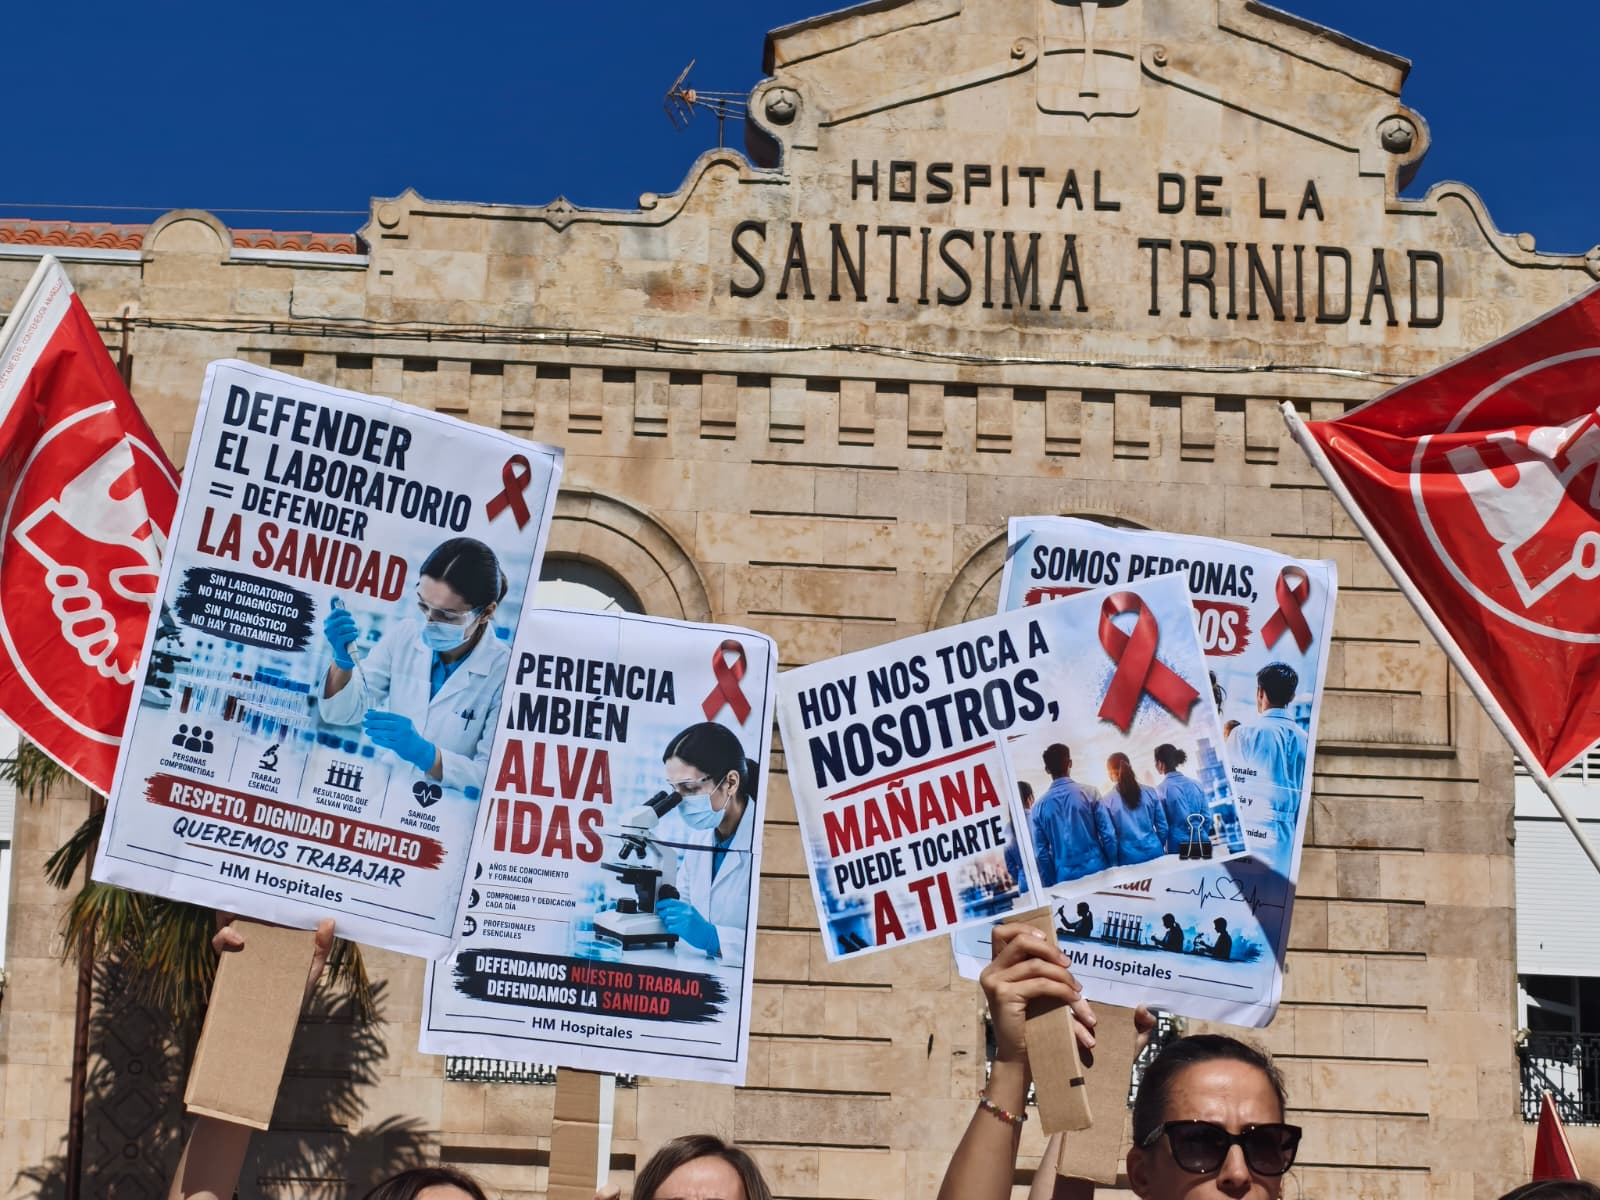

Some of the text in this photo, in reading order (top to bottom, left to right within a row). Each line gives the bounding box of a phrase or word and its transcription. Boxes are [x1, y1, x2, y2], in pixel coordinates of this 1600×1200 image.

[852, 159, 1324, 221] HOSPITAL DE LA
[730, 220, 1444, 328] SANTISIMA TRINIDAD
[223, 384, 412, 471] DEFENDER
[214, 431, 472, 532] EL LABORATORIO
[242, 483, 368, 541] DEFENDER
[196, 507, 408, 602] LA SANIDAD
[1030, 545, 1121, 586] SOMOS
[198, 584, 299, 619] NO HAY DIAGNÓSTICO
[210, 574, 294, 604] SIN LABORATORIO
[190, 613, 294, 648] NO HAY TRATAMIENTO
[204, 603, 287, 633] SIN DIAGNÓSTICO
[516, 652, 676, 705] PERIENCIA
[798, 620, 1049, 730] HOY NOS TOCA A
[808, 668, 1060, 789] NOSOTROS,
[160, 758, 215, 778] COMPROMETIDAS
[172, 752, 207, 767] PERSONAS
[494, 738, 613, 804] ALVA
[248, 780, 279, 794] ESENCIAL
[250, 771, 281, 785] TRABAJO
[313, 787, 369, 806] RESULTADOS QUE
[316, 797, 362, 814] SALVAN VIDAS
[823, 763, 1001, 858] MAÑANA
[169, 782, 421, 861] RESPETO, DIGNIDAD Y EMPLEO
[400, 817, 440, 833] PARA TODOS
[408, 810, 436, 823] SANIDAD
[488, 798, 604, 863] IDAS
[173, 816, 405, 888] QUEREMOS TRABAJAR
[834, 815, 1006, 895] PUEDE TOCARTE
[219, 861, 343, 903] HM Hospitales
[489, 863, 507, 872] AÑOS
[520, 866, 569, 879] CONOCIMIENTO
[485, 901, 503, 909] CADA
[486, 892, 530, 903] COMPROMISO
[874, 871, 958, 946] A TI
[482, 929, 522, 940] ESENCIALES
[484, 920, 536, 932] PROFESIONALES
[476, 955, 704, 999] DEFENDAMOS NUESTRO TRABAJO,
[1063, 949, 1172, 980] HM Hospitales
[487, 980, 671, 1016] DEFENDAMOS LA SANIDAD
[532, 1016, 633, 1039] HM Hospitales
